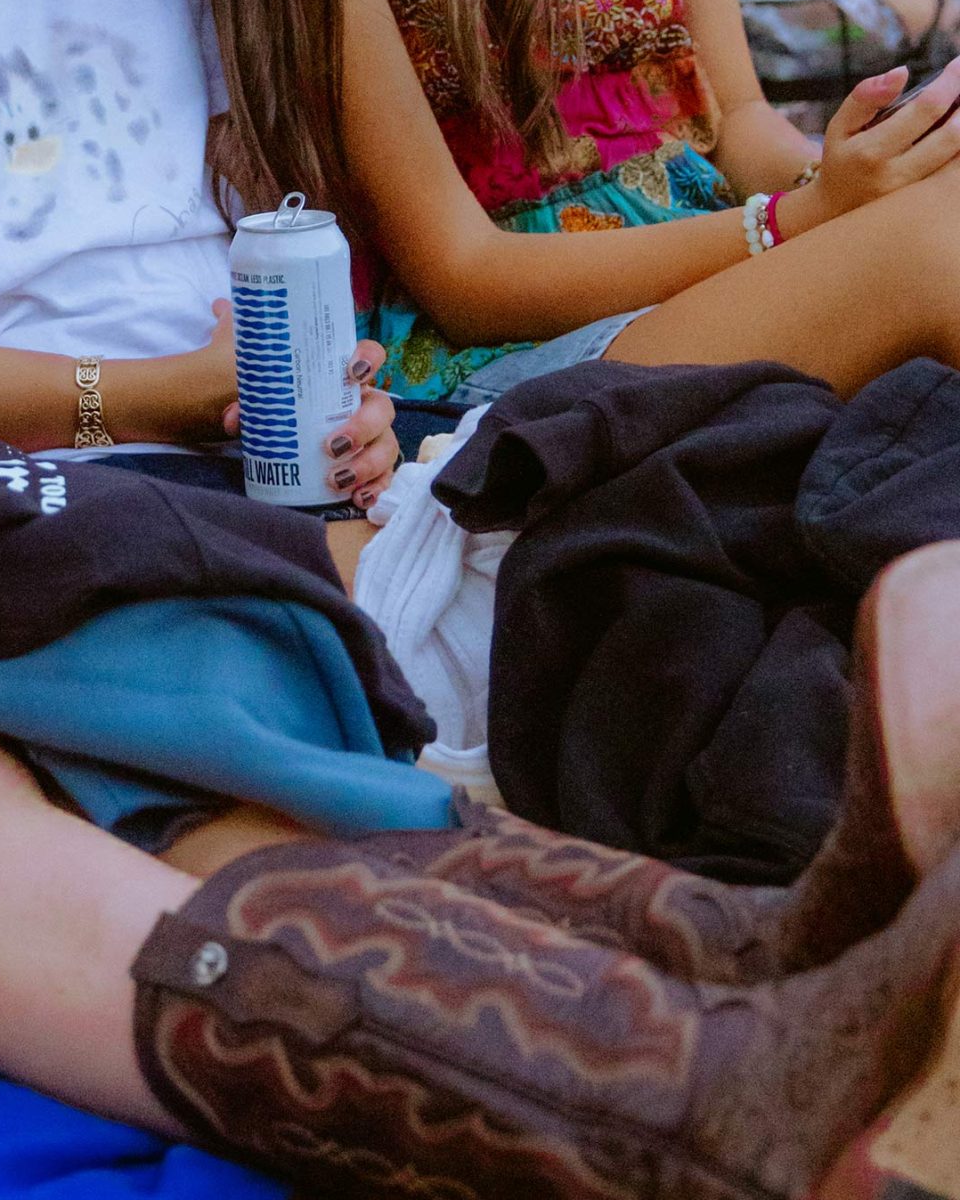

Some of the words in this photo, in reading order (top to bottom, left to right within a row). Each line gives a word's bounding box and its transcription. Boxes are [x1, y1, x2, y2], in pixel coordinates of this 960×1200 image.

[294, 348, 302, 373] Carbon
[296, 374, 304, 399] Neutral
[254, 460, 301, 486] WATER
